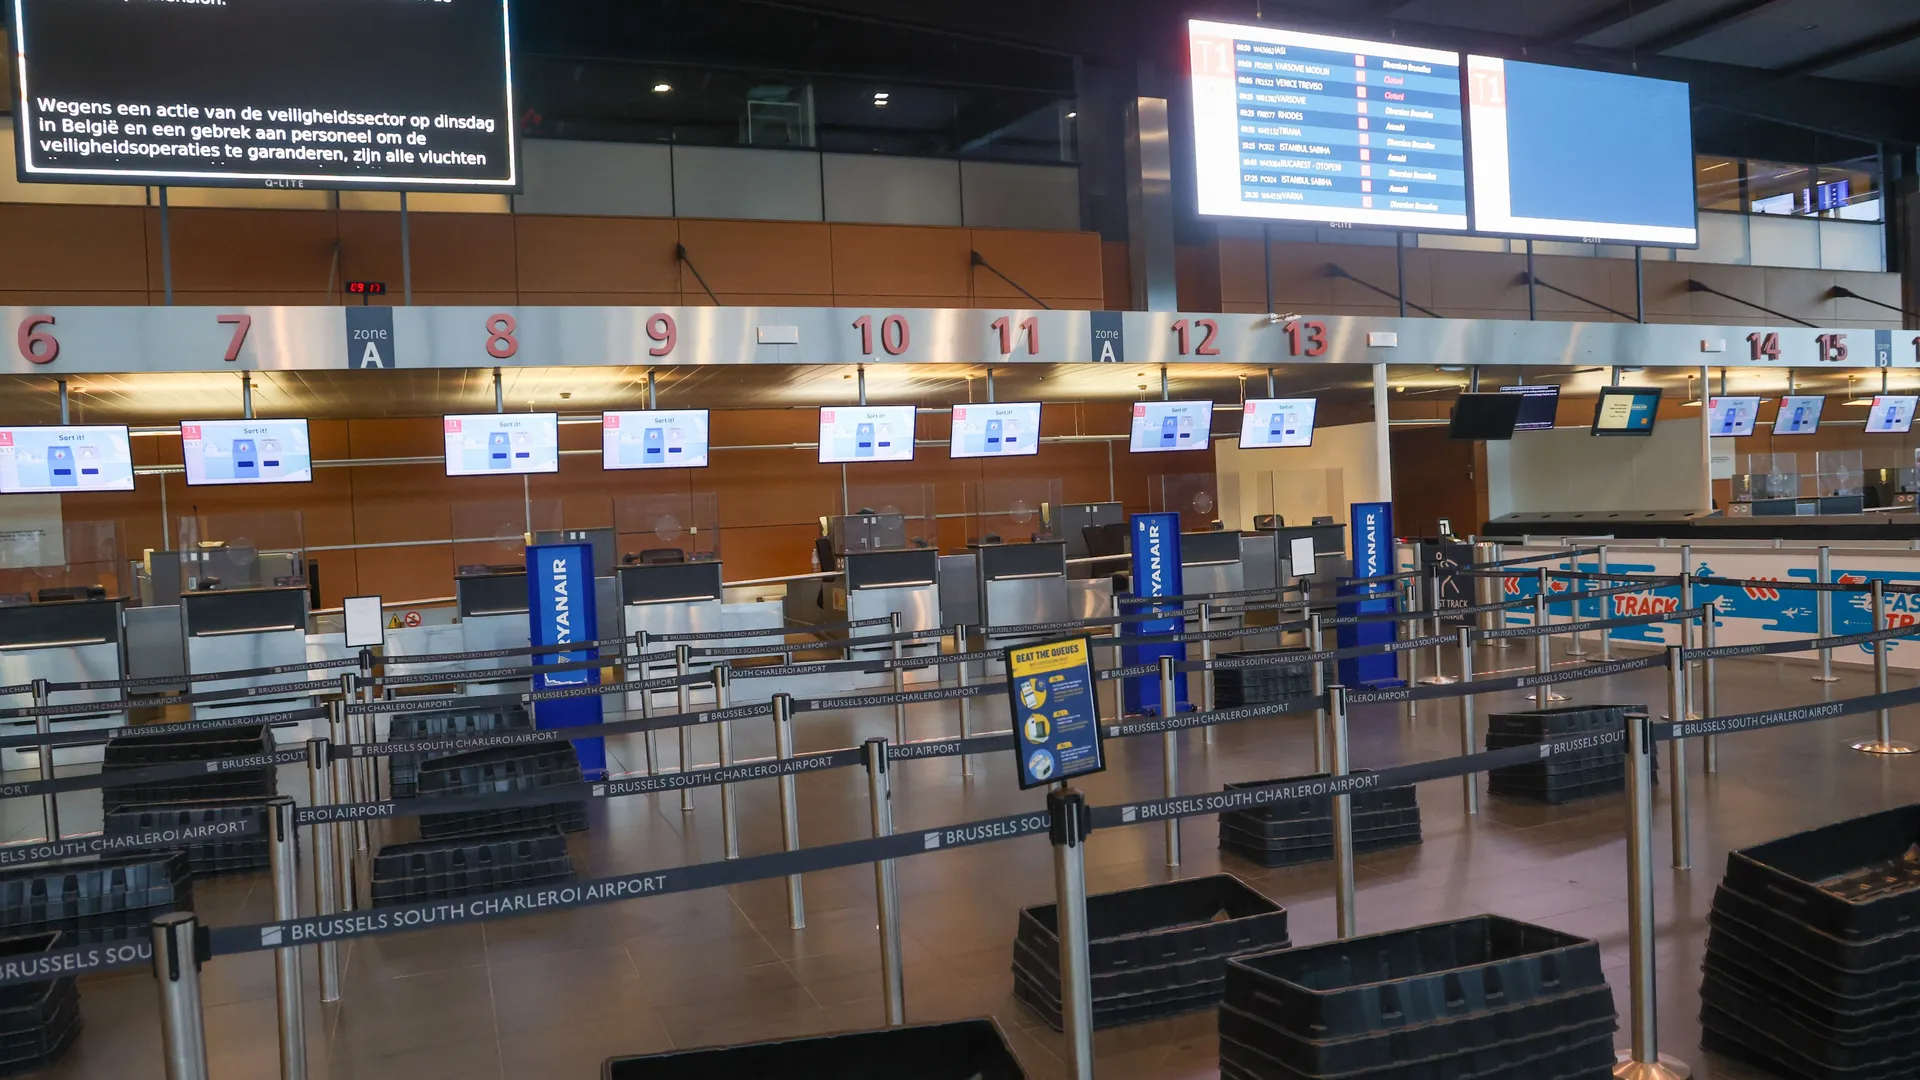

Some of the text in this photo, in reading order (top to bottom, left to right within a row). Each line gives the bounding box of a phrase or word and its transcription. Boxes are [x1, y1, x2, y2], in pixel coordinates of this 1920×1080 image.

[1197, 40, 1231, 74] T1
[1275, 62, 1304, 73] VARSOVIE
[1305, 66, 1330, 76] MODLIN
[1275, 78, 1323, 91] VENICE TREVISO
[1473, 73, 1502, 104] T1
[1277, 94, 1306, 105] VARSOVIE
[37, 97, 495, 133] Wegens een actie van de veiligheidssector op dinsdag
[1278, 110, 1303, 120] RHODES
[39, 117, 427, 146] in België en een gebrek aan personeel om de
[1279, 126, 1301, 136] TIRANA
[40, 138, 487, 165] veiligheidsoperaties te garanderen, zijn alle vluchten
[1280, 143, 1308, 153] ISTANBUL
[1280, 159, 1311, 169] BUCAREST
[265, 178, 304, 188] Q-LITE
[1281, 175, 1310, 185] ISTANBUL
[1281, 191, 1303, 201] VARNA
[1329, 221, 1352, 229] Q-LITE
[350, 283, 380, 293] 09 17
[18, 314, 60, 365] 6
[216, 314, 252, 362] 7
[353, 328, 387, 340] zone
[485, 313, 519, 358] 8
[645, 312, 677, 357] 9
[851, 313, 911, 356] 10
[990, 315, 1040, 356] 11
[1095, 328, 1119, 340] zone
[1171, 318, 1221, 356] 12
[1282, 320, 1329, 357] 13
[360, 341, 385, 369] A
[1099, 340, 1117, 363] A
[1746, 331, 1782, 361] 14
[1815, 333, 1848, 362] 15
[1879, 351, 1888, 367] B
[1149, 525, 1162, 605] RYANAIR
[553, 558, 571, 652] RYANAIR
[1446, 599, 1468, 608] TRACK
[1614, 594, 1679, 616] TRACK
[1884, 592, 1920, 613] FAS
[1181, 625, 1282, 641] BRUSSELS SOUTH CHARLEROI AIRPORT
[1491, 623, 1590, 637] BRUSSELS SOUTH CHARLEROI AIRPORT
[1016, 651, 1035, 664] BEAT
[1035, 649, 1050, 660] THE
[1051, 644, 1079, 657] QUEUES
[1215, 652, 1334, 669] BRUSSELS SOUTH CHARLEROI AIRPORT
[385, 669, 516, 684] BRUSSELS SOUTH CHARLEROI AIRPORT
[1526, 659, 1648, 685] BRUSSELS SOUTH CHARLEROI AIRPORT
[1378, 690, 1411, 700] AIRPORT
[347, 700, 453, 713] UTH CHARLEROI AIRPORT
[711, 704, 772, 721] BRUSSELS SOU
[122, 713, 293, 736] BRUSSELS SOUTH CHARLEROI AIRPORT
[1123, 703, 1290, 735] BRUSSELS SOUTH CHARLEROI AIRPORT
[1685, 703, 1844, 735] BRUSSELS SOUTH CHARLEROI AIRPORT
[367, 731, 558, 755] BRUSSELS SOUTH CHARLEROI AIRPORT
[915, 743, 961, 755] AIRPORT
[1553, 730, 1625, 755] BRUSSELS SOUT
[222, 750, 306, 769] BRUSSELS SOUT
[610, 756, 833, 794] BRUSSELS SOUTH CHARLEROI AIRPORT
[1141, 775, 1380, 818] BRUSSELS SOUTH CHARLEROI AIRPORT
[336, 803, 395, 818] AIRPORT
[30, 842, 87, 860] SOUTH
[91, 829, 181, 851] CHARLEROI
[183, 820, 247, 838] AIRPORT
[946, 817, 1051, 845] BRUSSELS SOU
[292, 875, 667, 940] BRUSSELS SOUTH CHARLEROI AIRPORT
[106, 942, 152, 963] SOU
